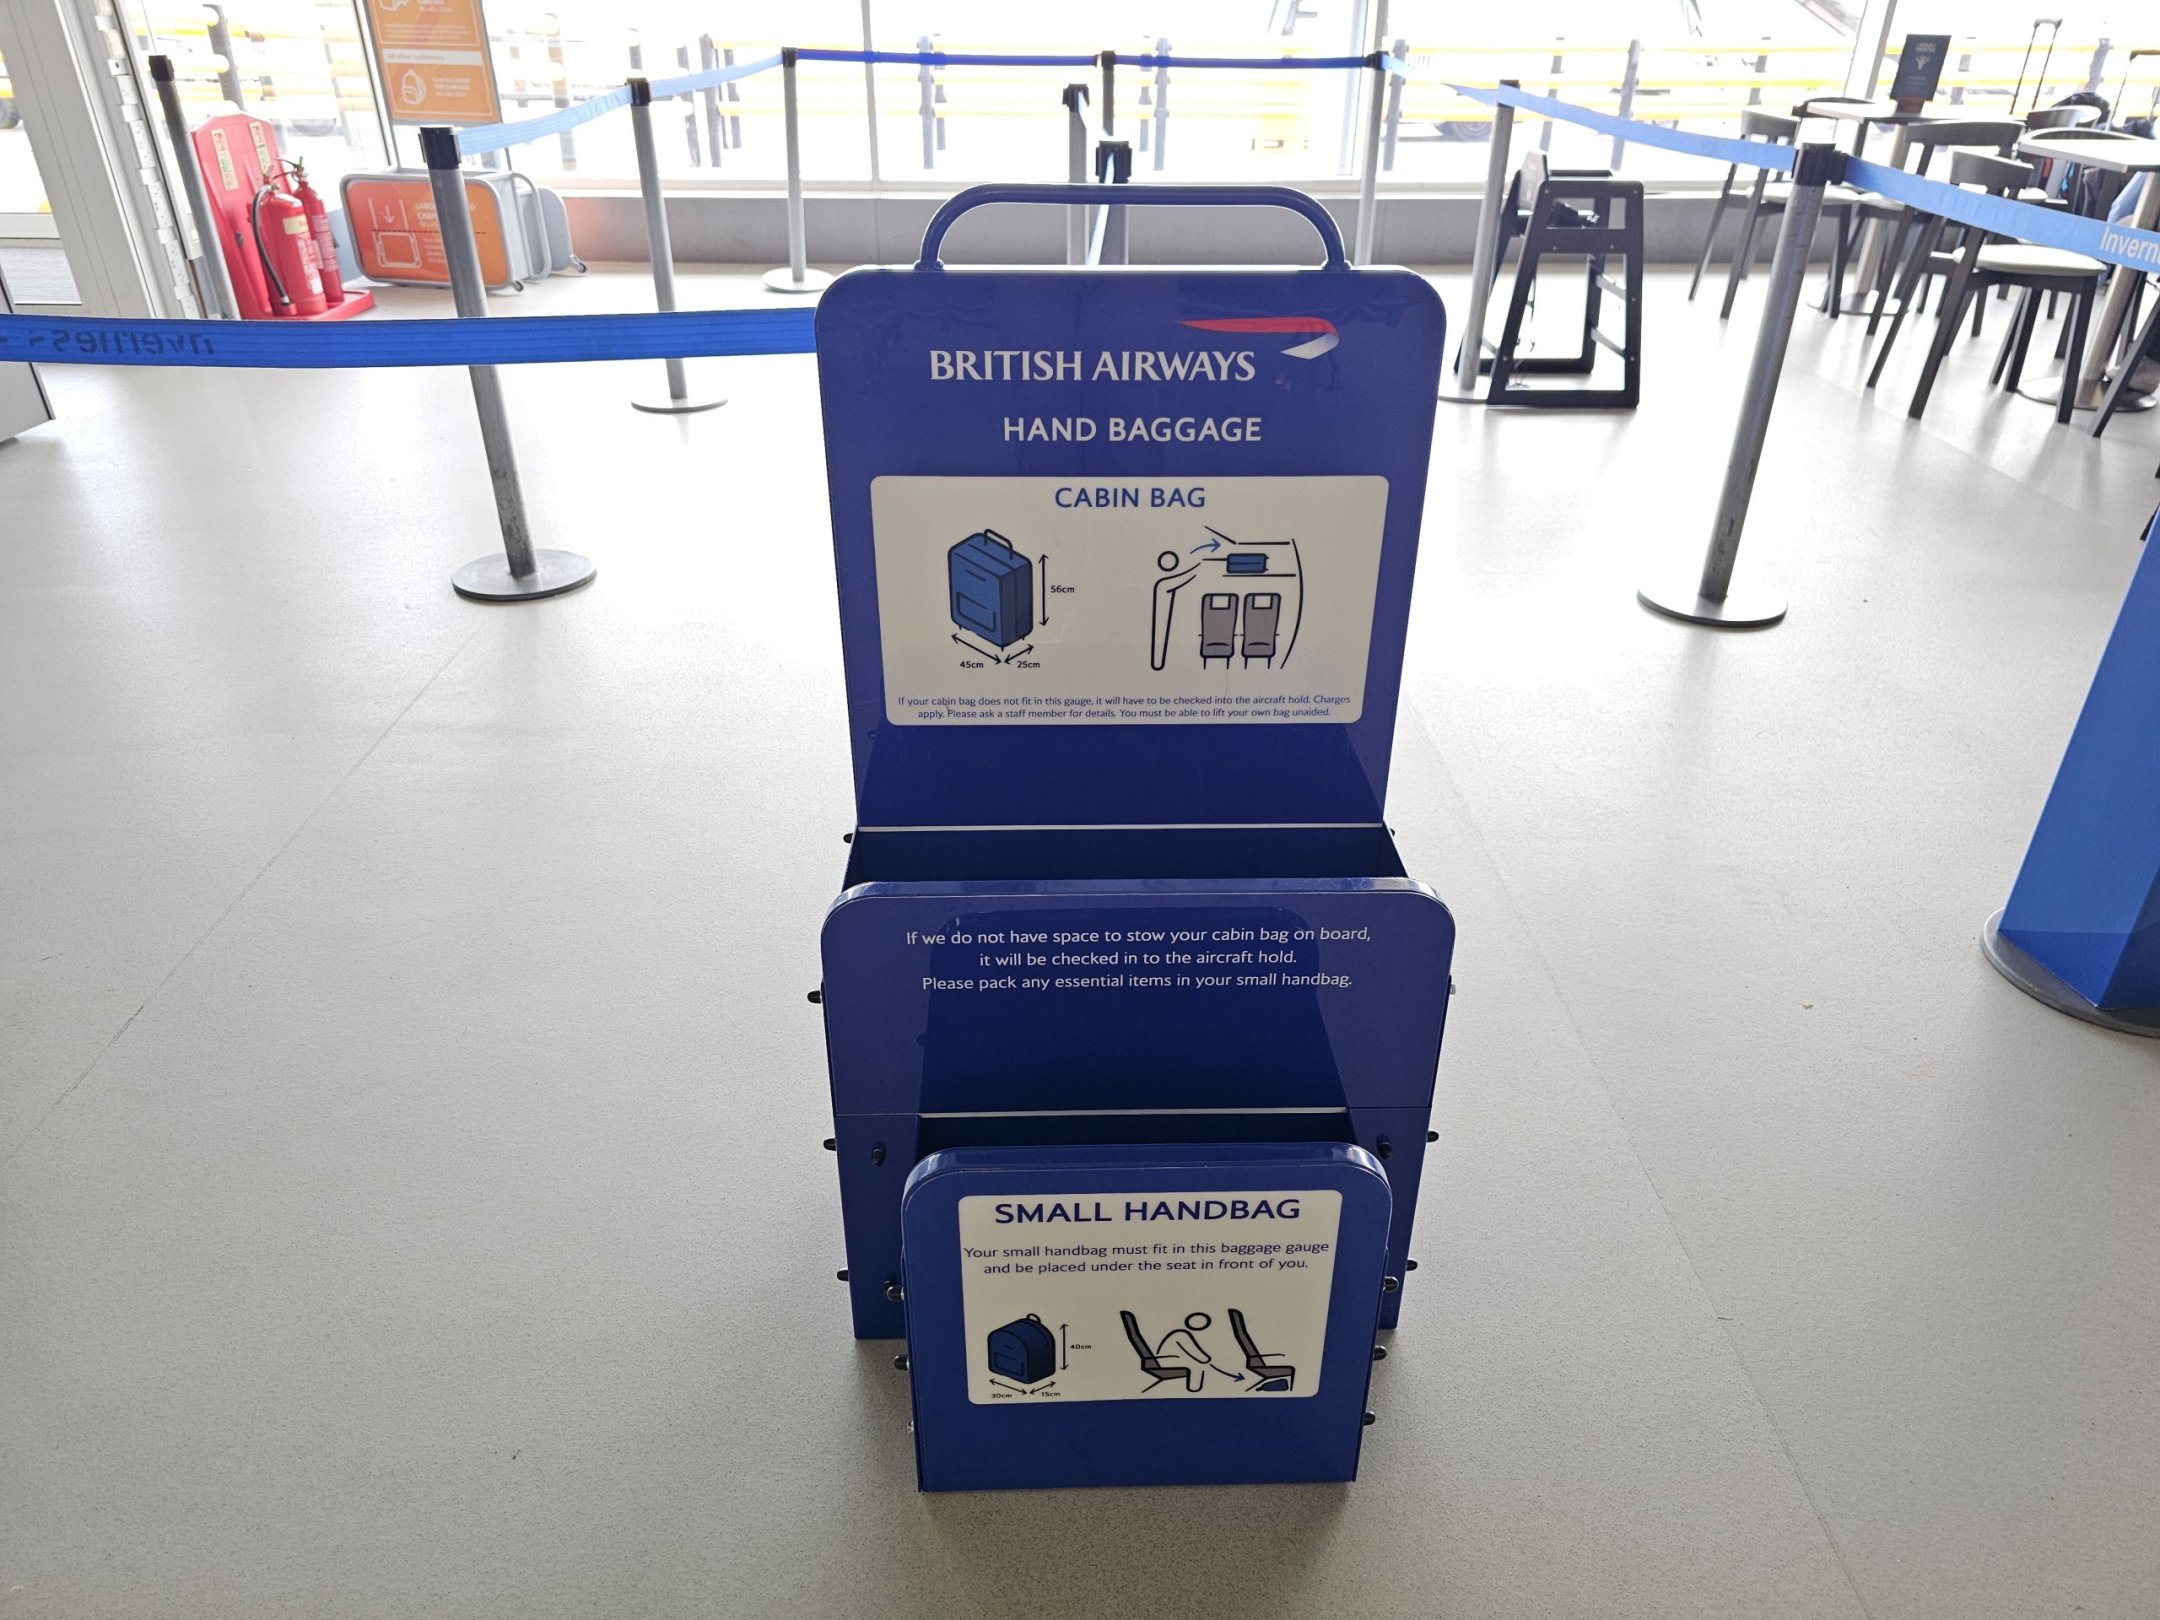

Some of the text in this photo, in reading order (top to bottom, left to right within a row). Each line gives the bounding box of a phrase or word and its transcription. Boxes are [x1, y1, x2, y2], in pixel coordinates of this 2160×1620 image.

[2099, 224, 2160, 265] Invern
[930, 351, 1255, 381] BRITISH AIRWAYS
[1004, 417, 1261, 441] HAND BAGGAGE
[1055, 488, 1205, 508] CABIN BAG
[1050, 584, 1075, 594] 56cm
[959, 660, 984, 669] 45cm
[1016, 660, 1041, 669] 25cm
[898, 694, 1351, 708] If your cabin bag does not fit in this gauge, it will have to be checked into the aircraft hold. Charges
[918, 709, 945, 720] apply.
[947, 708, 977, 718] Please
[979, 709, 995, 718] ask
[1005, 708, 1026, 718] staff
[1028, 709, 1067, 718] member
[1069, 708, 1083, 718] for
[1085, 708, 1117, 718] details.
[1119, 708, 1137, 718] You
[1139, 710, 1162, 718] must
[1164, 708, 1177, 718] be
[1178, 708, 1199, 717] able
[1200, 709, 1211, 717] to
[1212, 707, 1225, 717] lift
[1227, 709, 1249, 719] your
[1250, 709, 1271, 717] own
[1273, 708, 1291, 719] bag
[1292, 707, 1331, 717] unaided.
[906, 926, 1371, 946] If we do not have space to stow your cabin bag on board,
[979, 950, 1297, 967] it will be checked in to the aircraft hold.
[922, 972, 1353, 992] Please pack any essential items in your small handbag.
[996, 1199, 1299, 1223] SMALL HANDBAG
[963, 1242, 1330, 1258] Your small handbag must fit in this baggage gauge
[983, 1257, 1309, 1275] and be placed under the seat in front of you.
